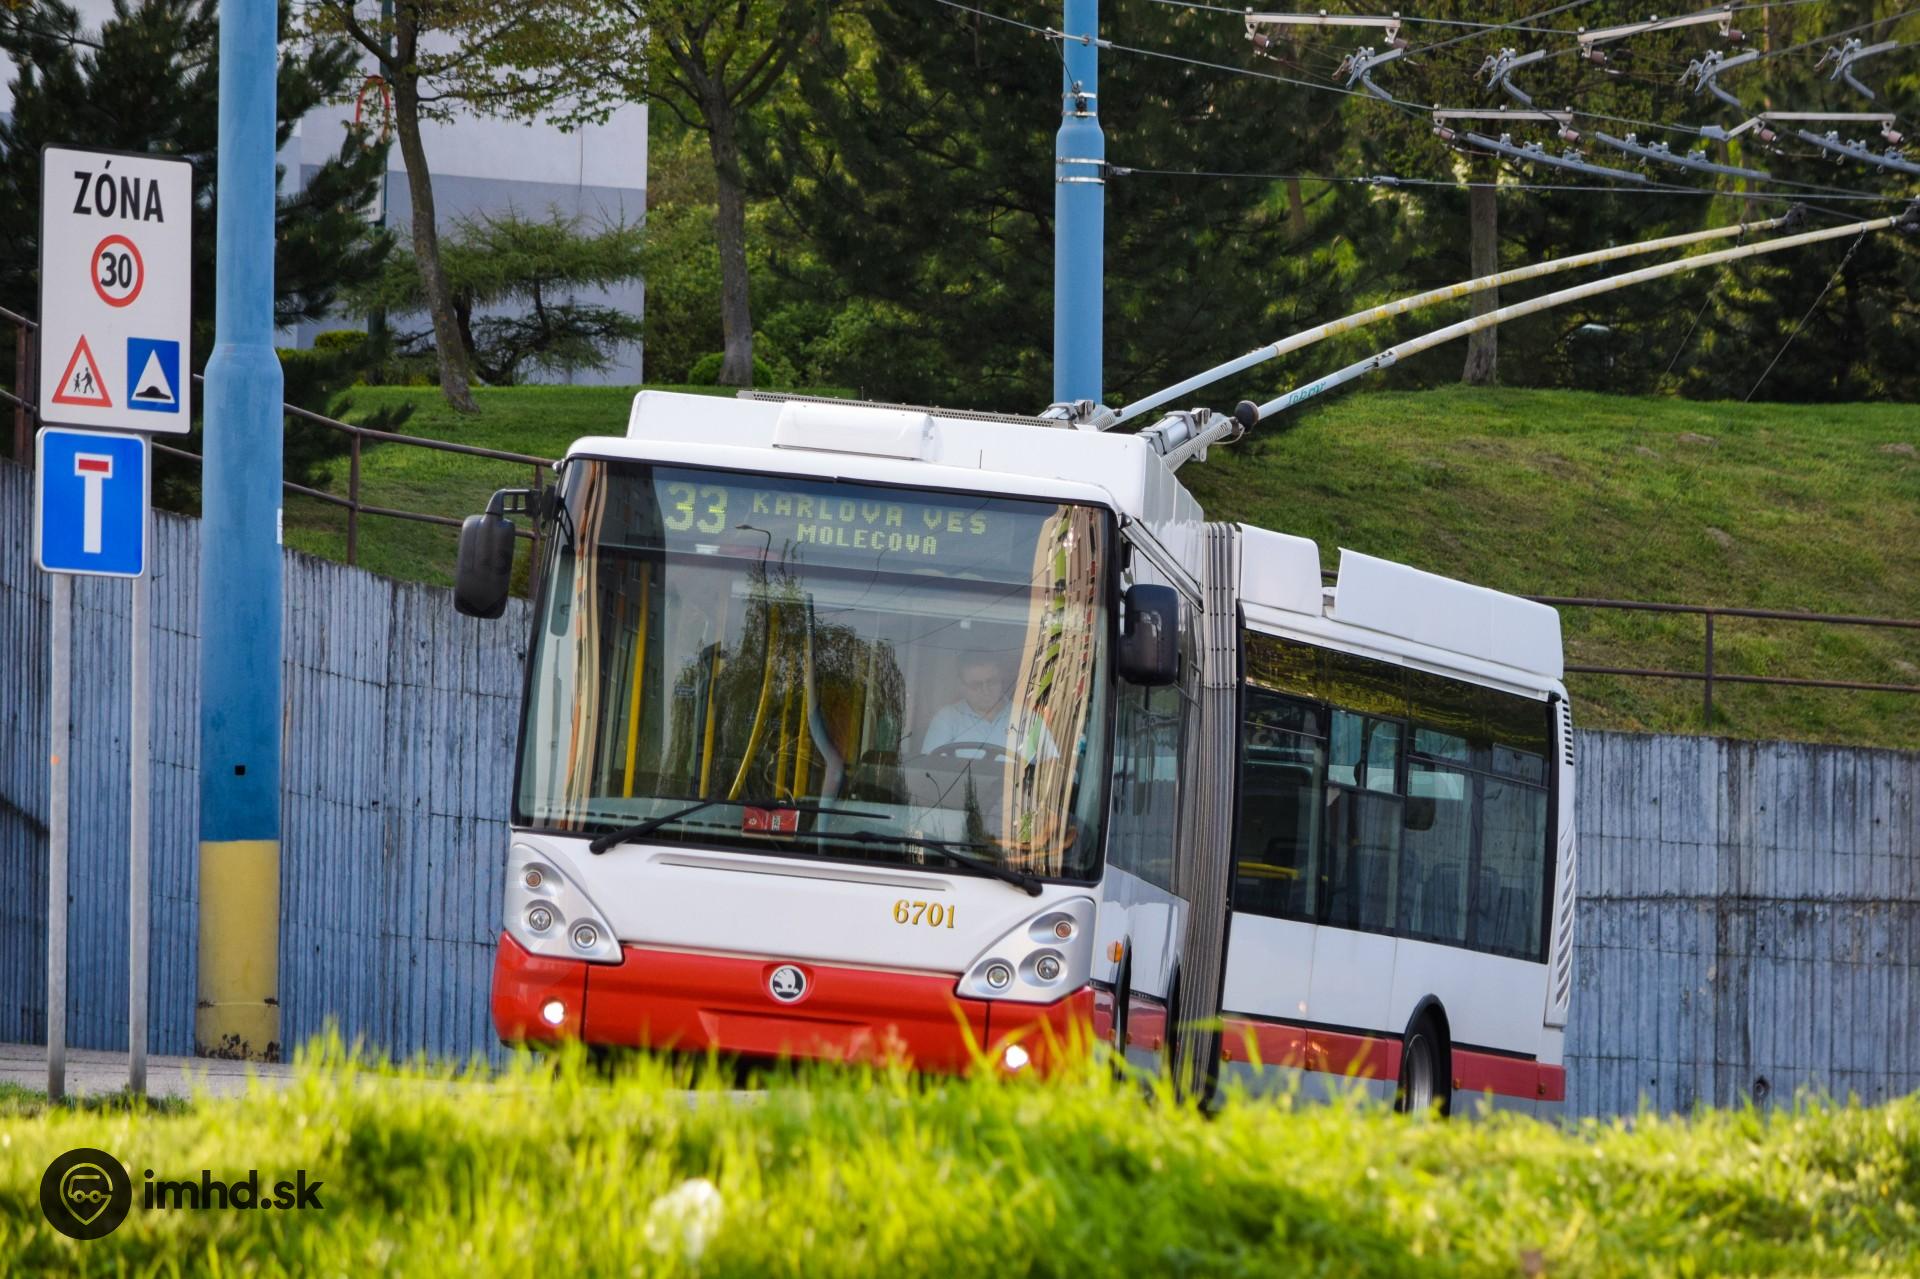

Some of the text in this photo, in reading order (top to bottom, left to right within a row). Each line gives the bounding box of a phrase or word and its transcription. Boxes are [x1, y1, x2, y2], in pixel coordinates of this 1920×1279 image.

[73, 160, 164, 223] ZÓNA
[100, 252, 132, 289] 30
[665, 484, 987, 535] 33 KARLOVA VES
[797, 523, 937, 555] MOLECOVA
[893, 899, 955, 928] 6701
